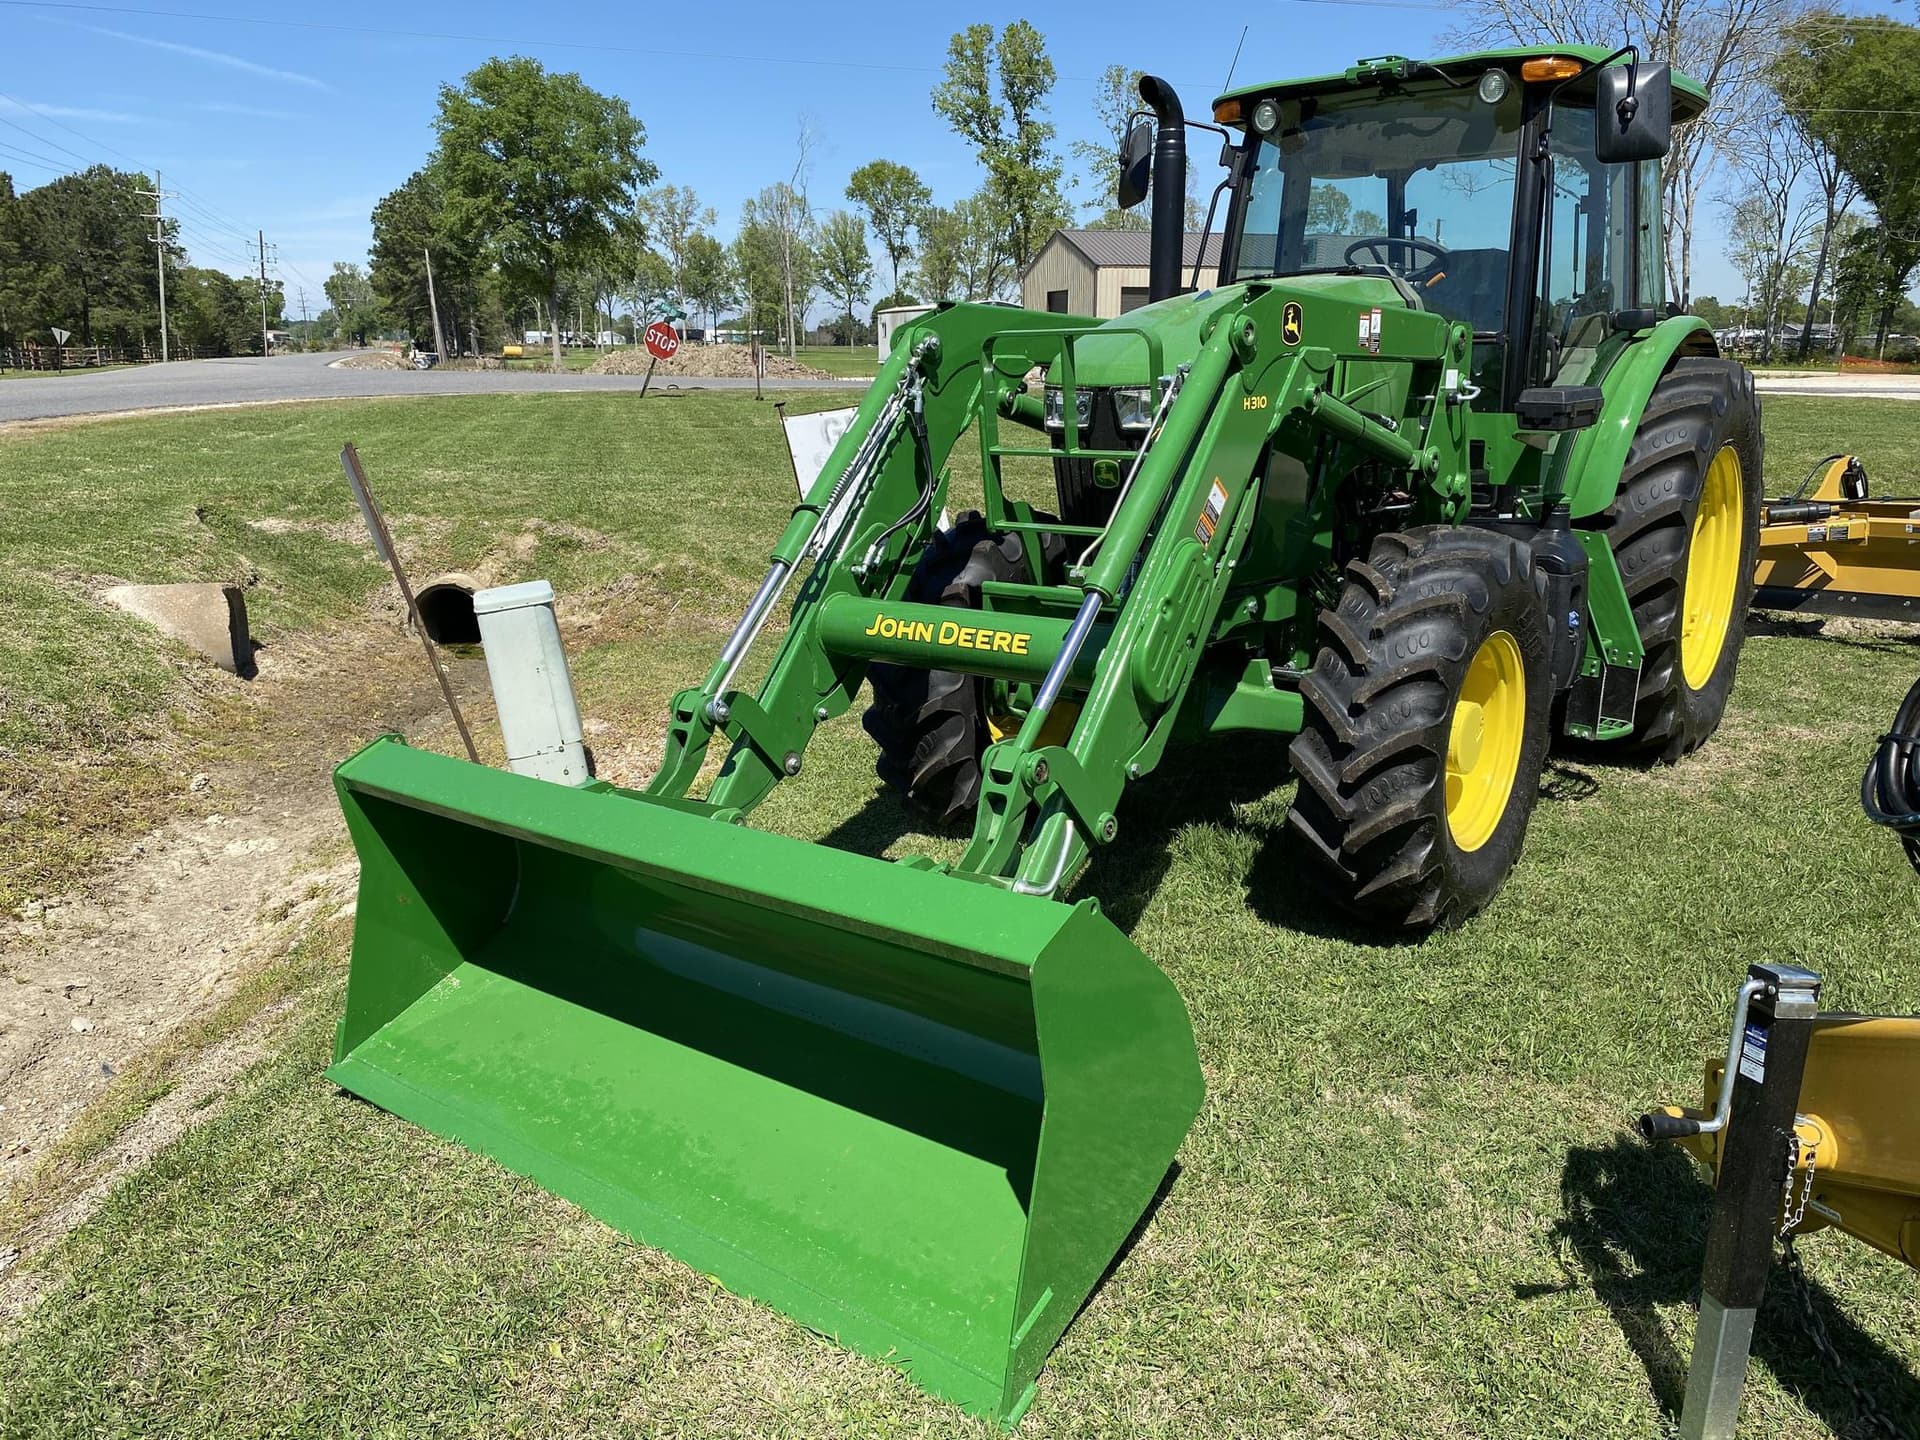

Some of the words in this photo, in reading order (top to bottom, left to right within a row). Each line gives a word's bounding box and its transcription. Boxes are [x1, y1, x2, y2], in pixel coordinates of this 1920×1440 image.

[647, 329, 676, 351] STOP
[1243, 396, 1267, 410] H310
[865, 612, 935, 642] JOHN
[938, 621, 1031, 655] DEERE
